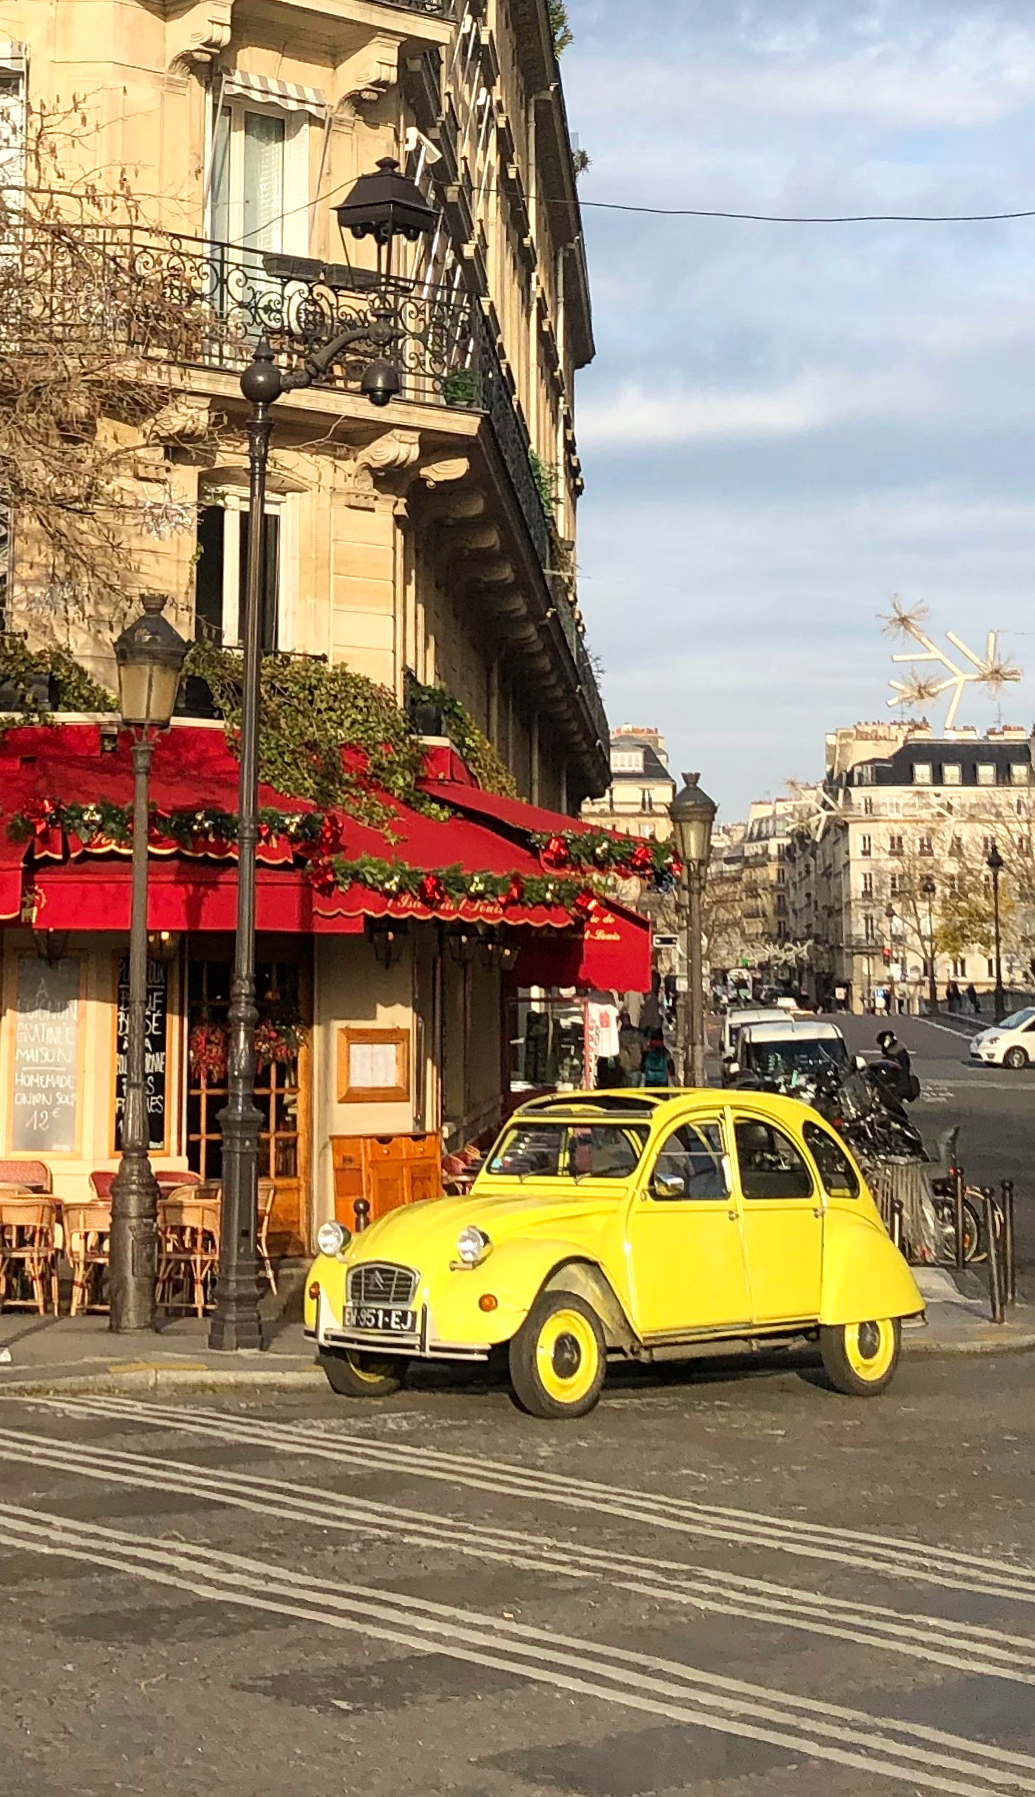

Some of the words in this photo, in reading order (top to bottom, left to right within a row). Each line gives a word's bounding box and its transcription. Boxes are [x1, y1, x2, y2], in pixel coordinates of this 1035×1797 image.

[16, 1048, 72, 1063] MAISON
[14, 1072, 75, 1089] HOMEMADE
[14, 1092, 53, 1106] ONION
